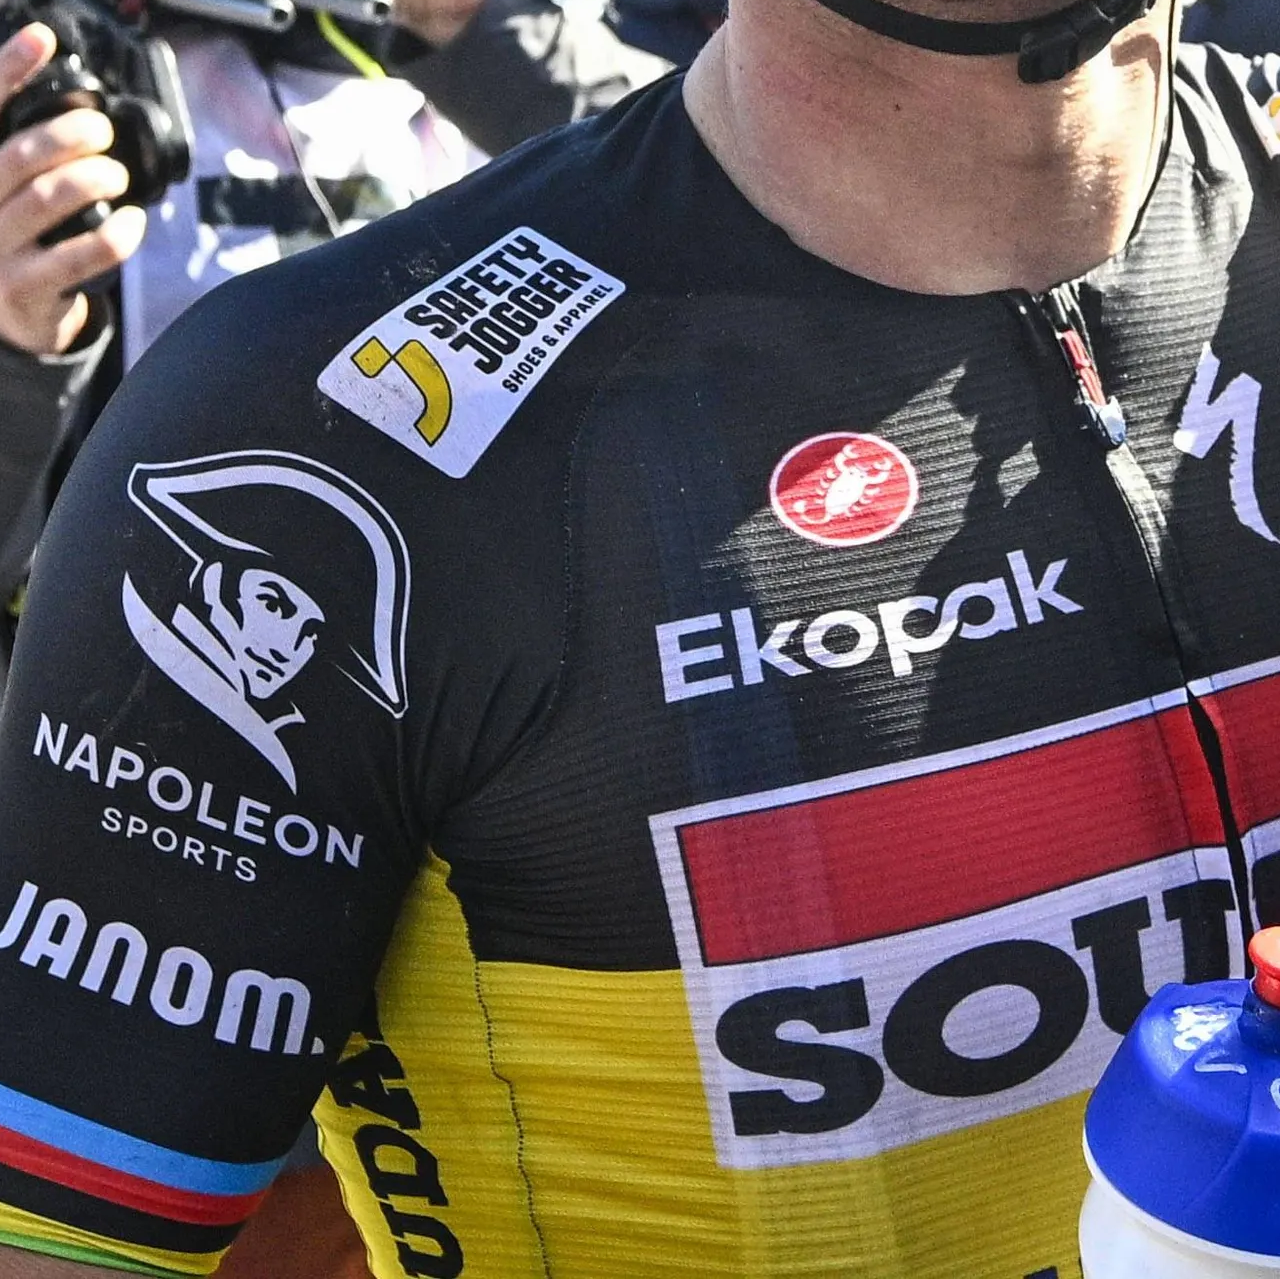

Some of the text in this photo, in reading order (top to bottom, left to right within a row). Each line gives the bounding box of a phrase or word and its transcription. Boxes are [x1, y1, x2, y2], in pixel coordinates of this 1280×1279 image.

[404, 235, 547, 341] SAFETY
[448, 258, 594, 375] JOGGER
[501, 284, 614, 394] SHOES & APPAREL
[655, 549, 1085, 704] Ekopak
[32, 712, 365, 869] NAPOLEON
[101, 806, 258, 882] SPORTS
